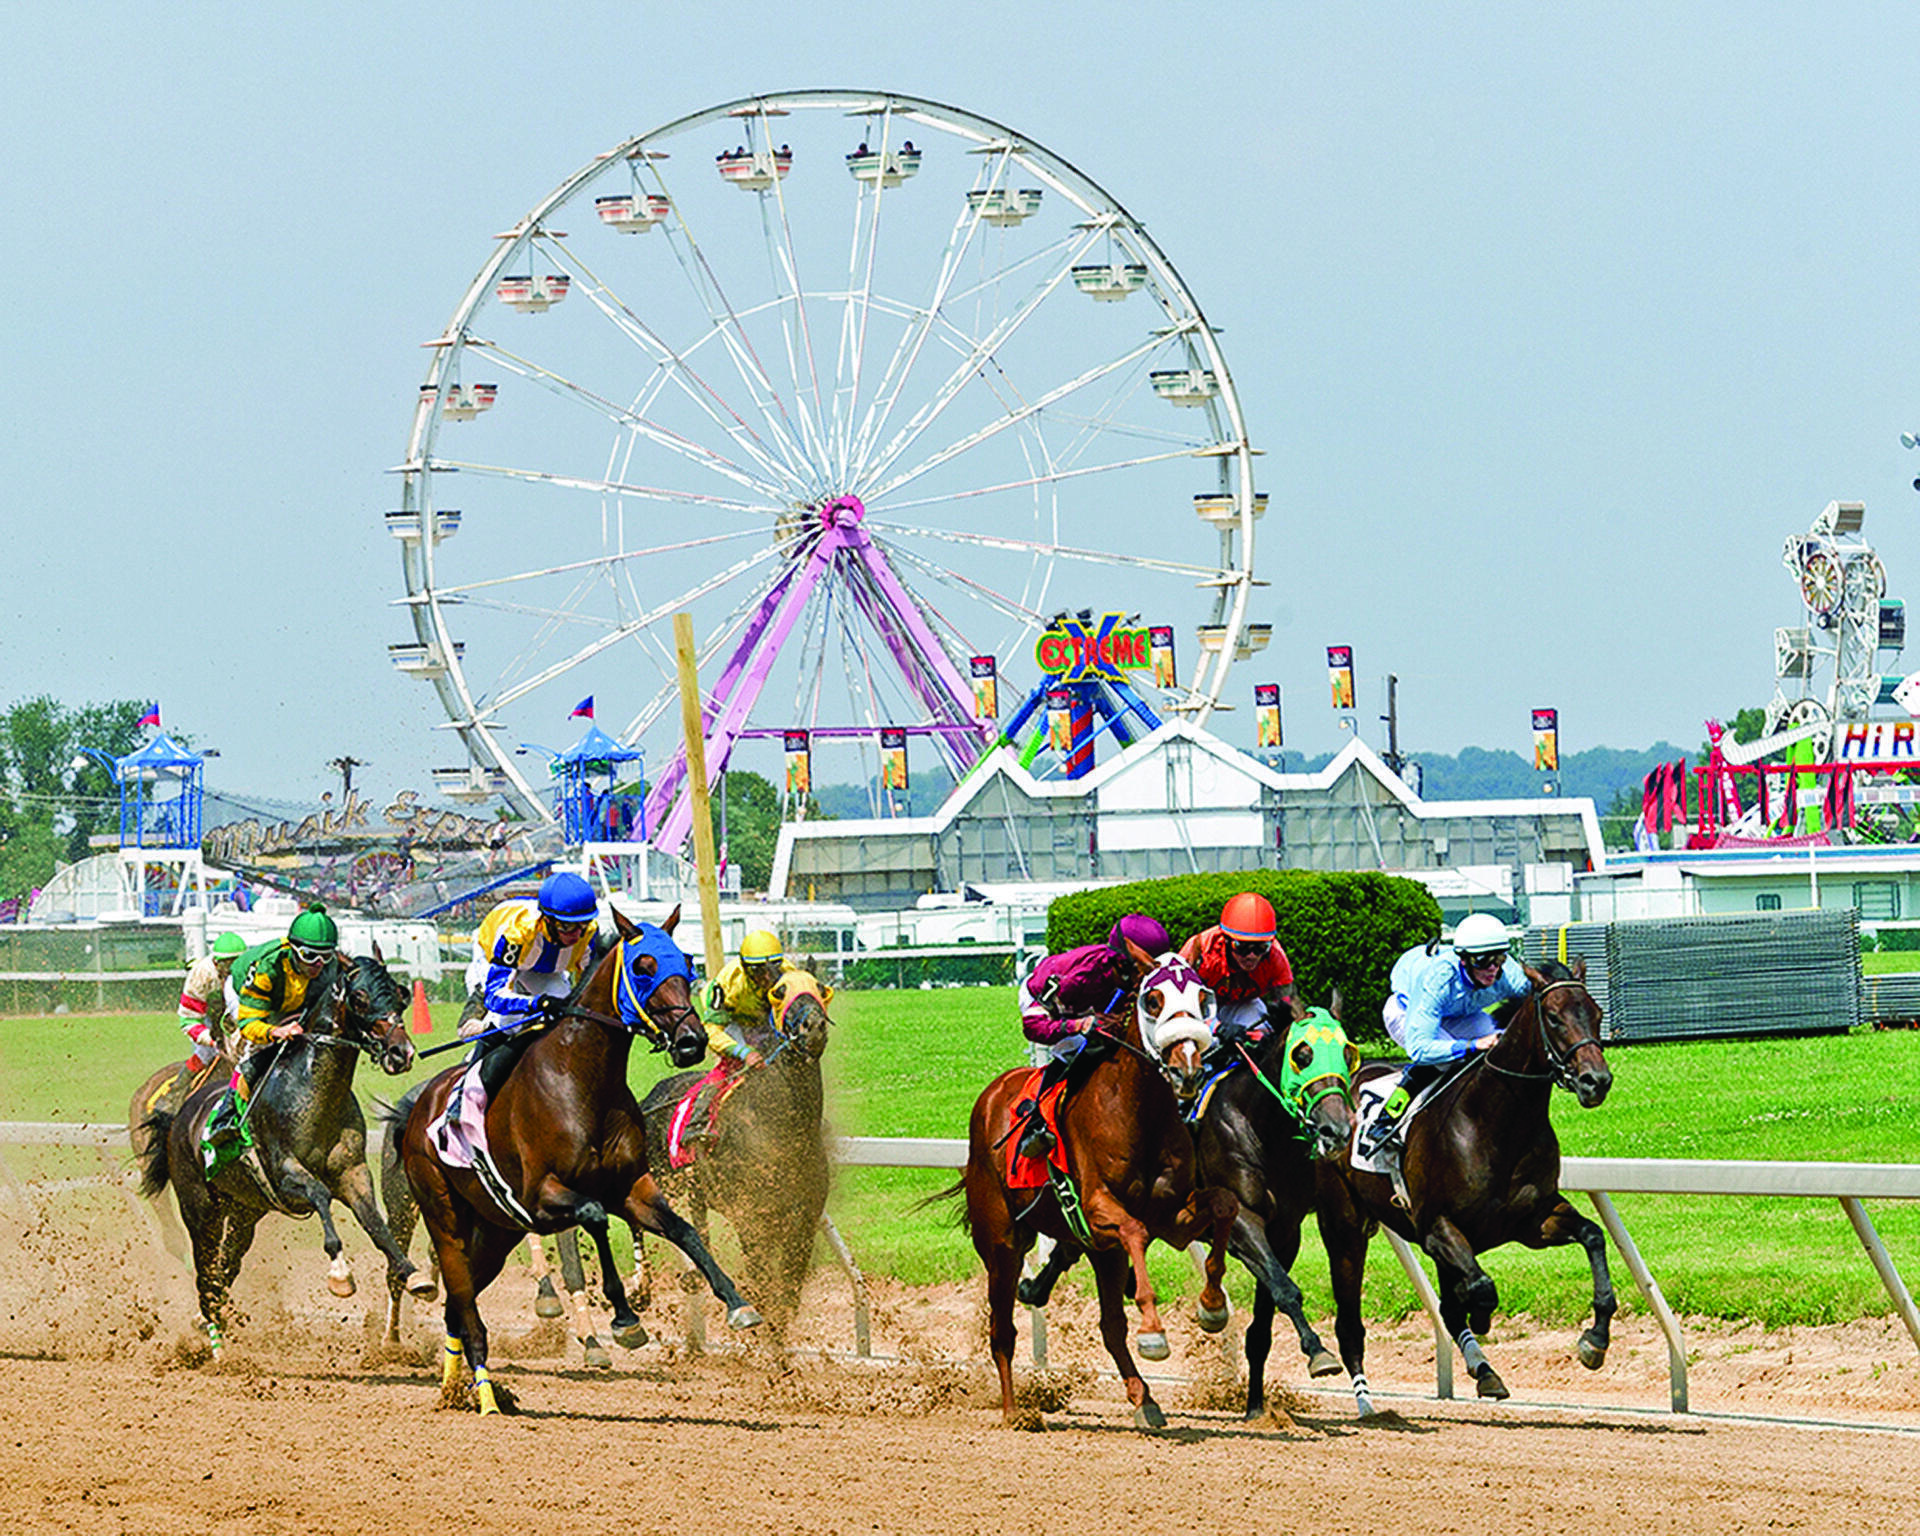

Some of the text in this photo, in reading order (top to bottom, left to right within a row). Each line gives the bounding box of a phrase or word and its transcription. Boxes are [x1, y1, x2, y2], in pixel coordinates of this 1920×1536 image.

[1040, 633, 1147, 668] EXTREME
[503, 943, 518, 965] 8
[1168, 965, 1185, 983] T
[1042, 979, 1059, 1002] 7
